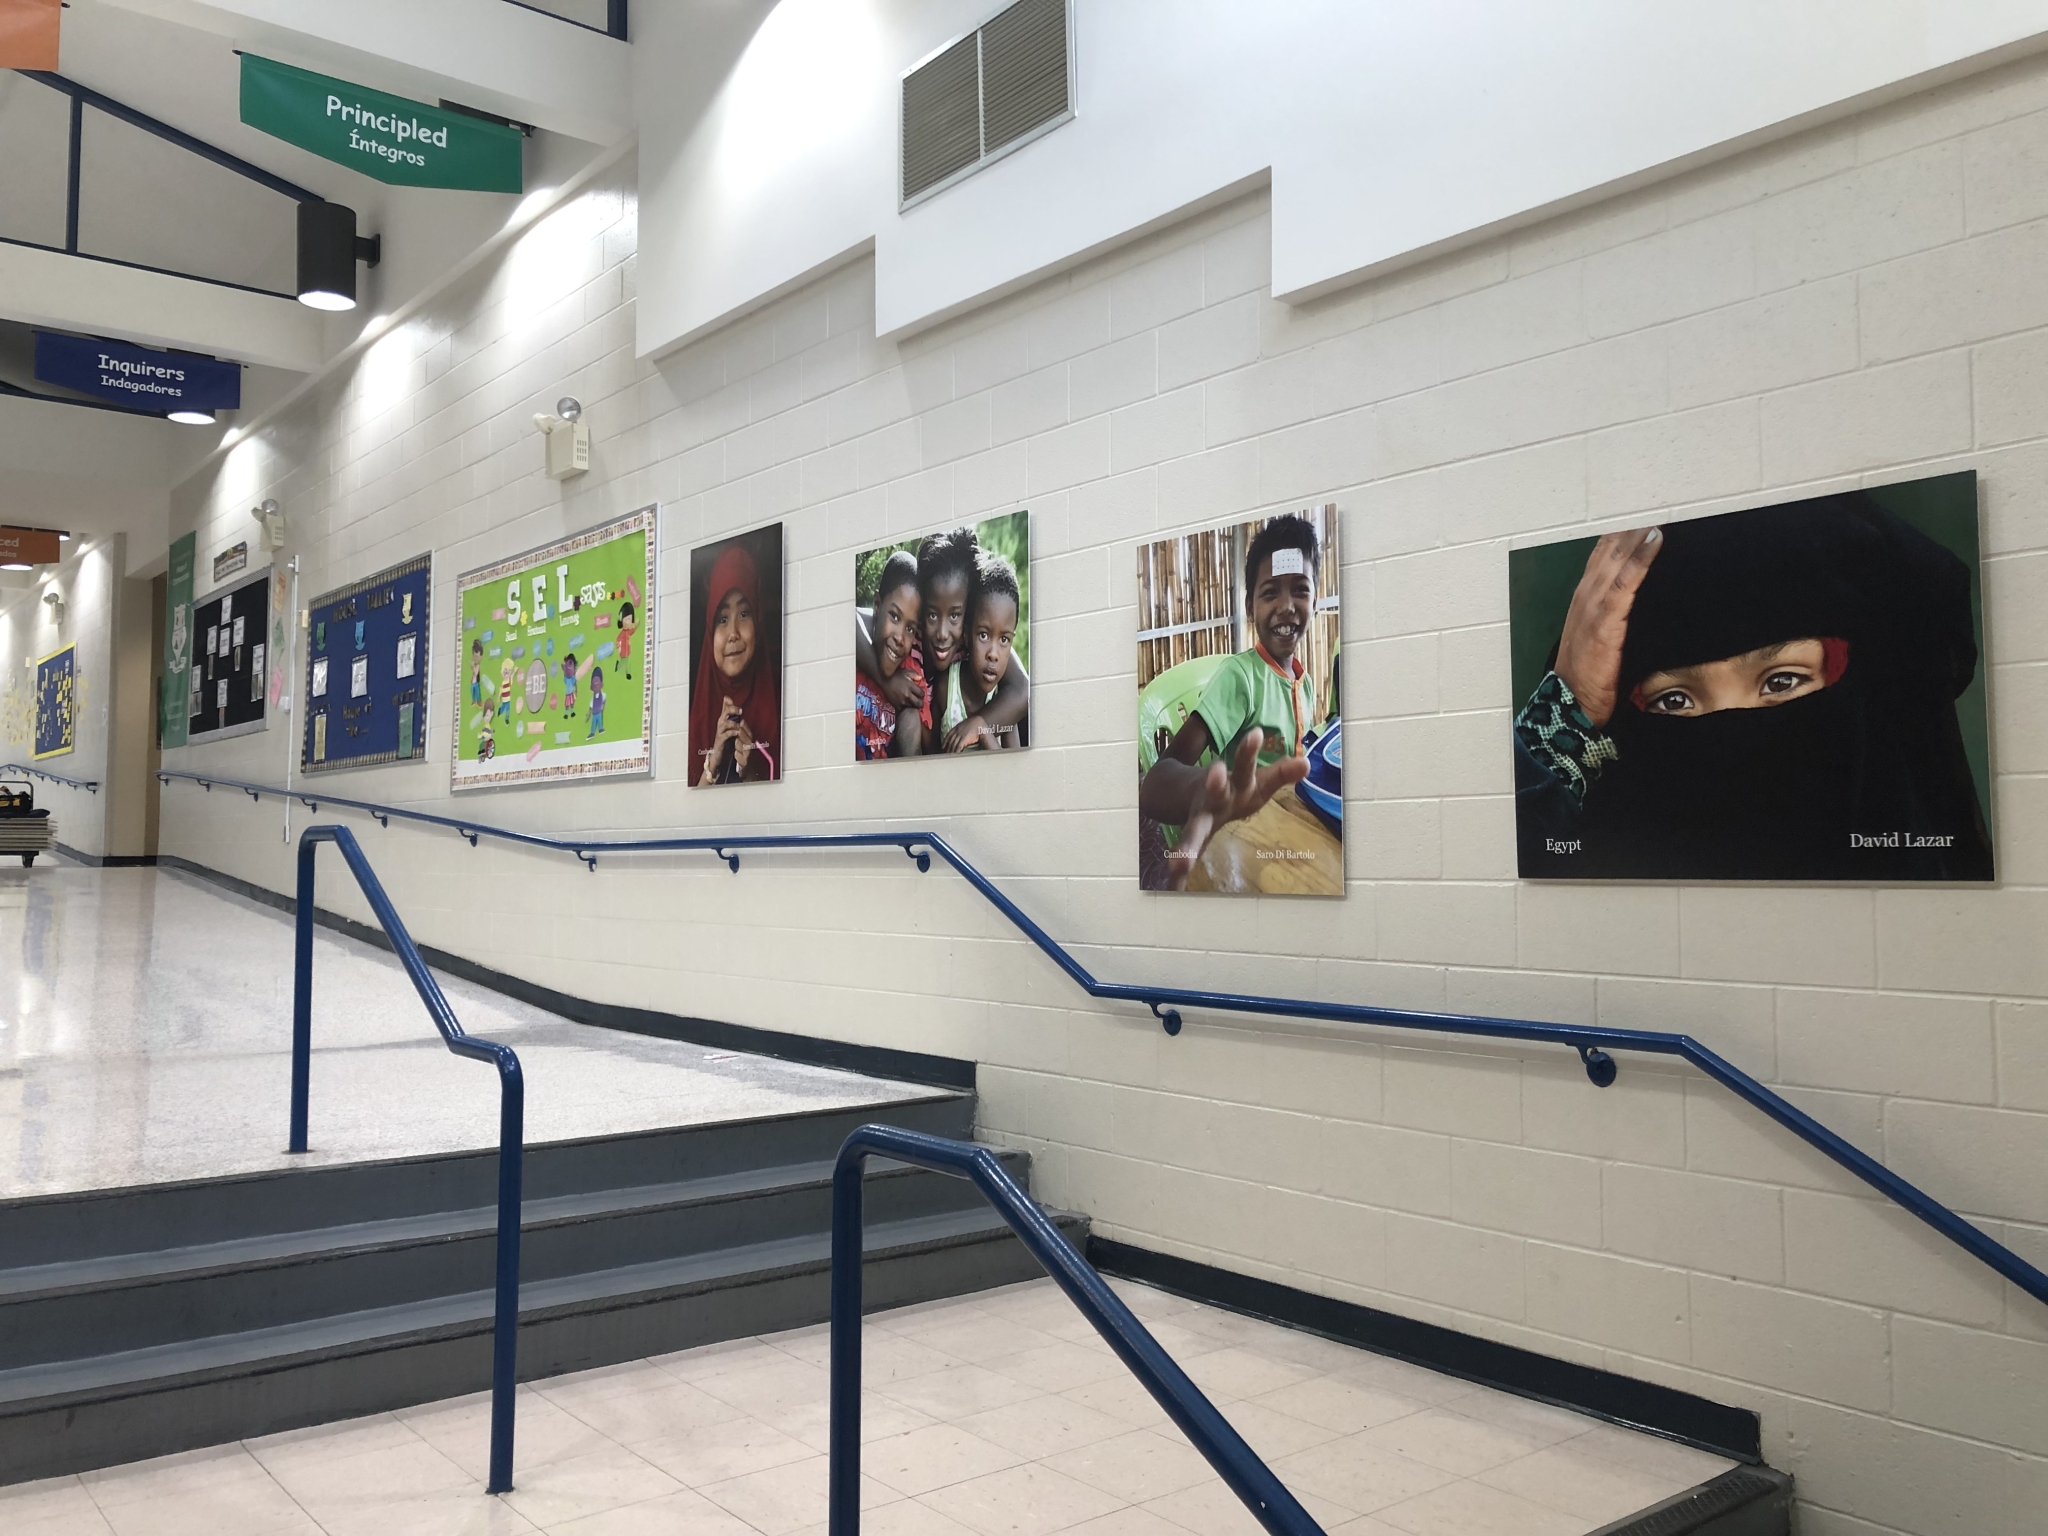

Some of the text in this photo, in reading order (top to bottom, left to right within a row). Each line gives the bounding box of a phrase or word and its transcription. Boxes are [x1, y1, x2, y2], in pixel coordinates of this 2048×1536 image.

[327, 95, 447, 148] Principled
[349, 129, 425, 166] Íntegros
[98, 354, 185, 381] Inquirers
[101, 375, 182, 397] Indagadores
[580, 581, 606, 608] says
[525, 674, 546, 696] #BE
[978, 724, 1014, 735] David Lazar
[1545, 838, 1582, 854] Egypt
[1849, 832, 1954, 848] David Lazar
[1163, 849, 1198, 859] Cambodia
[1256, 850, 1315, 860] Saro Di Bartolo
